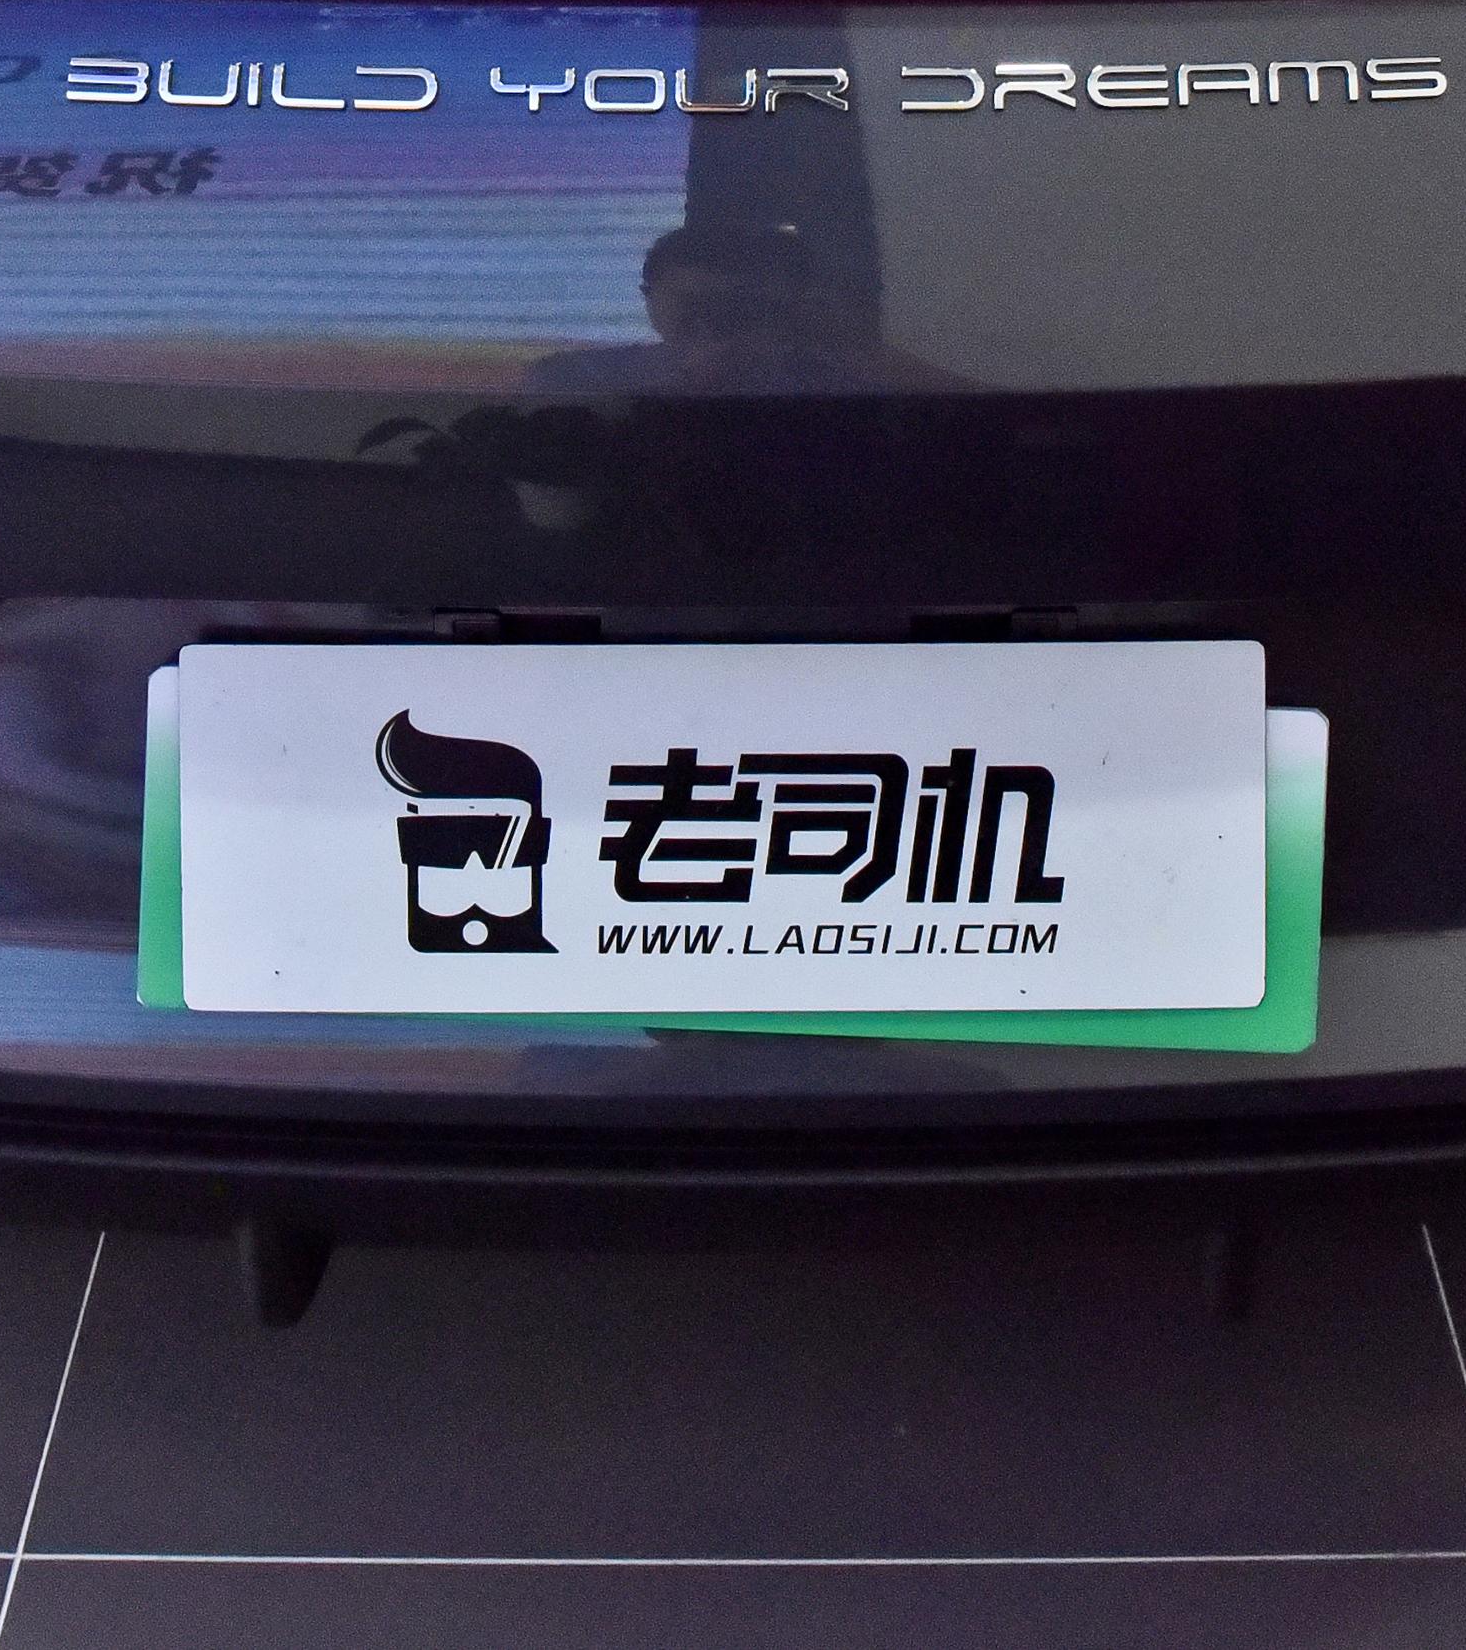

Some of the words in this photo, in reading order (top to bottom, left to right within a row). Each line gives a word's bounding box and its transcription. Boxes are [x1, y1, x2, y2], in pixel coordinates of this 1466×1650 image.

[66, 57, 436, 110] BUILD
[490, 66, 849, 114] YOUR
[901, 56, 1449, 112] DREAMS
[598, 747, 1066, 903] 老司机
[597, 923, 1059, 955] WWW.LAOSIJI.COM
